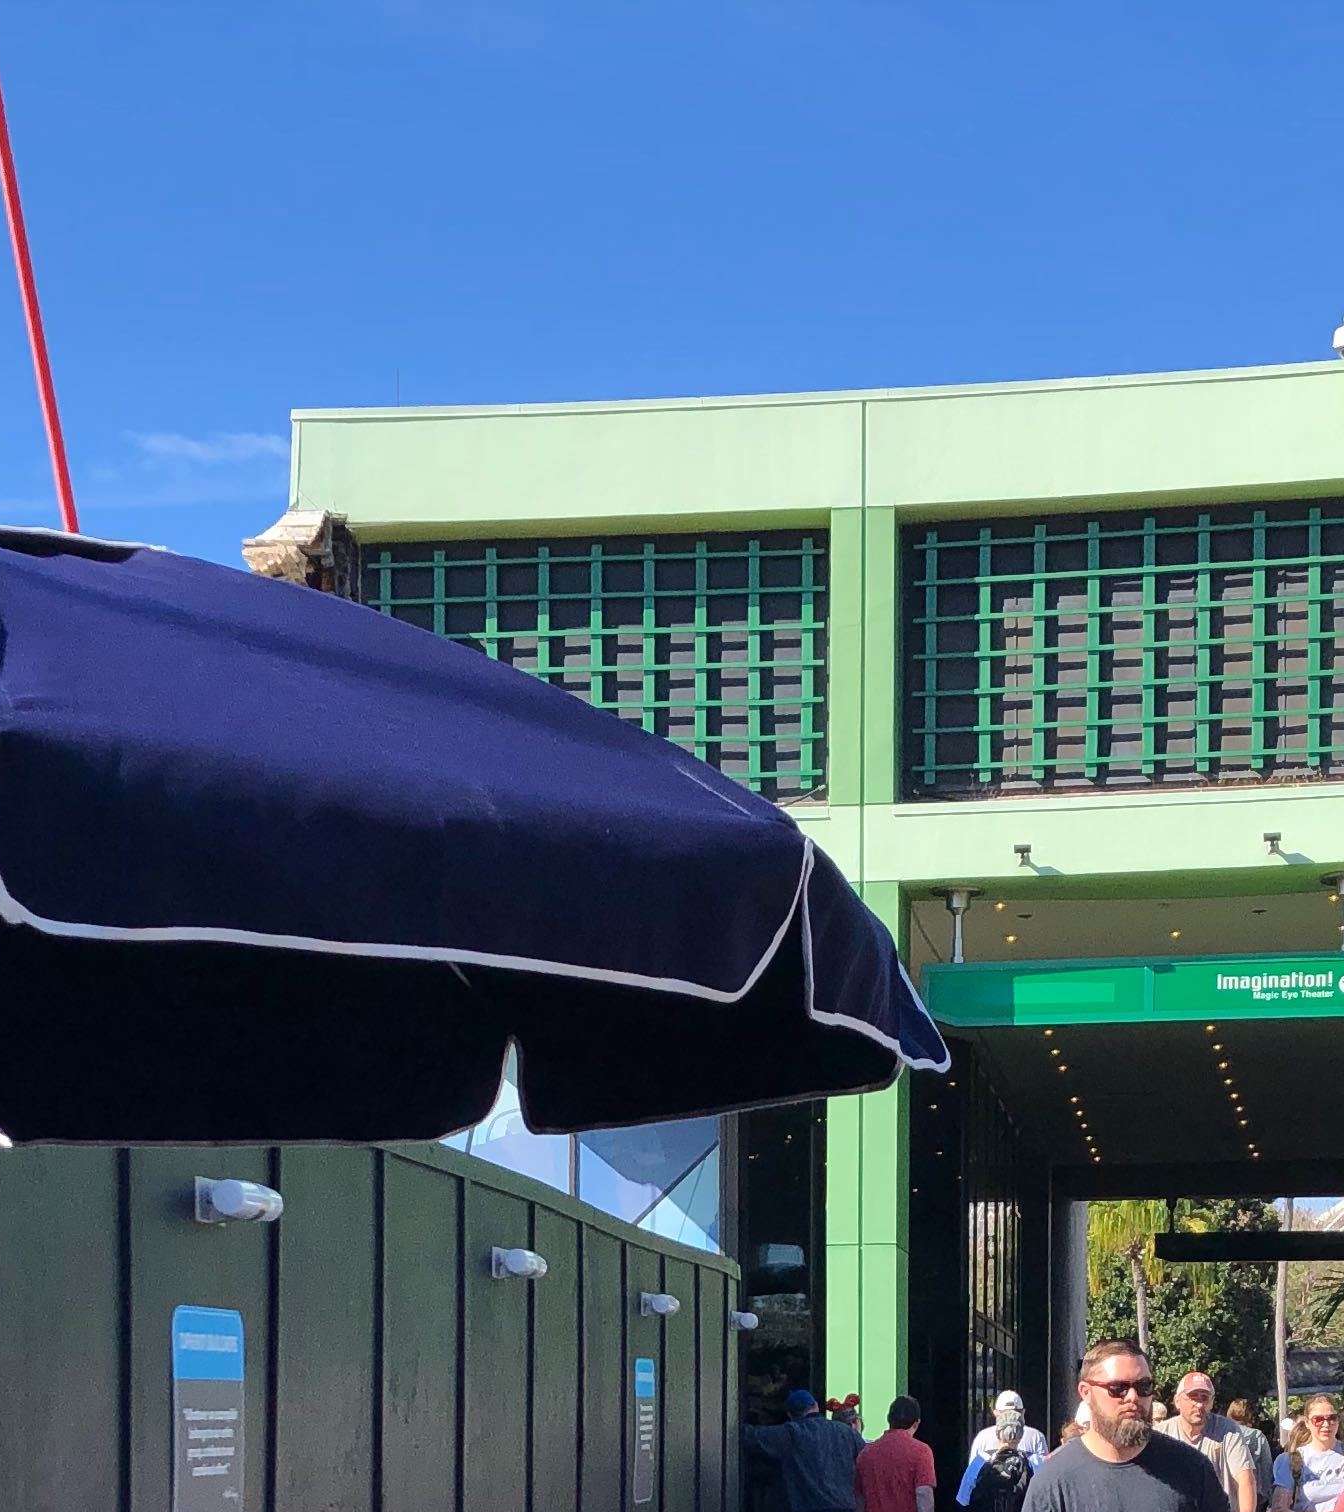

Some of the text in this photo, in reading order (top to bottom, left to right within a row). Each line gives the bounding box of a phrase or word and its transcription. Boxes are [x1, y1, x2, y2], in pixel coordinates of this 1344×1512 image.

[1216, 970, 1334, 991] Imagination!
[1252, 989, 1335, 1001] Magic Eye Theater
